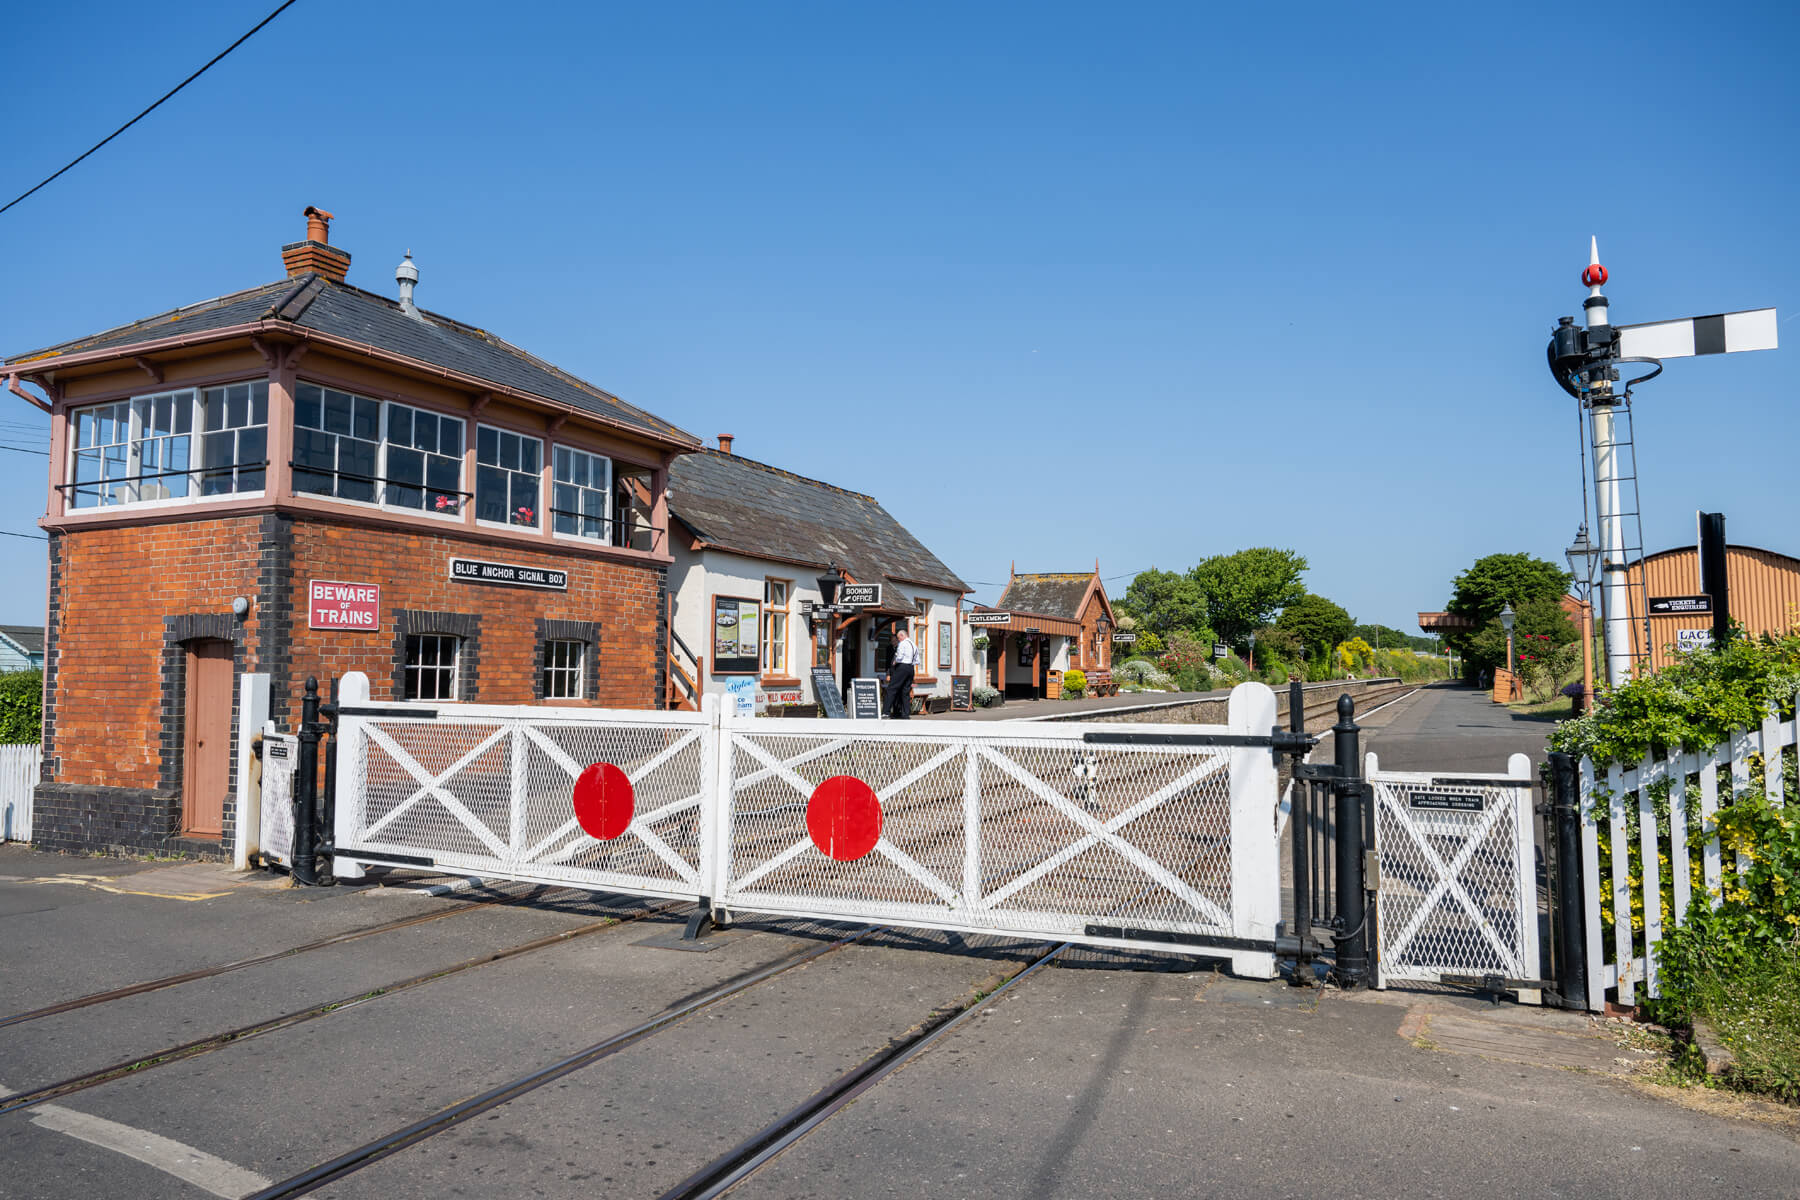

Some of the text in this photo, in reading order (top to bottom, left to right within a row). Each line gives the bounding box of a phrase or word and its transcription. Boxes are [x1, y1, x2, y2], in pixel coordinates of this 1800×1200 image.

[455, 563, 564, 585] BLUE ANCHOR SIGNAL BOX
[313, 585, 376, 603] BEWARE
[846, 587, 873, 595] BOOKING
[316, 609, 373, 624] TRAINS
[1680, 631, 1711, 639] LACT
